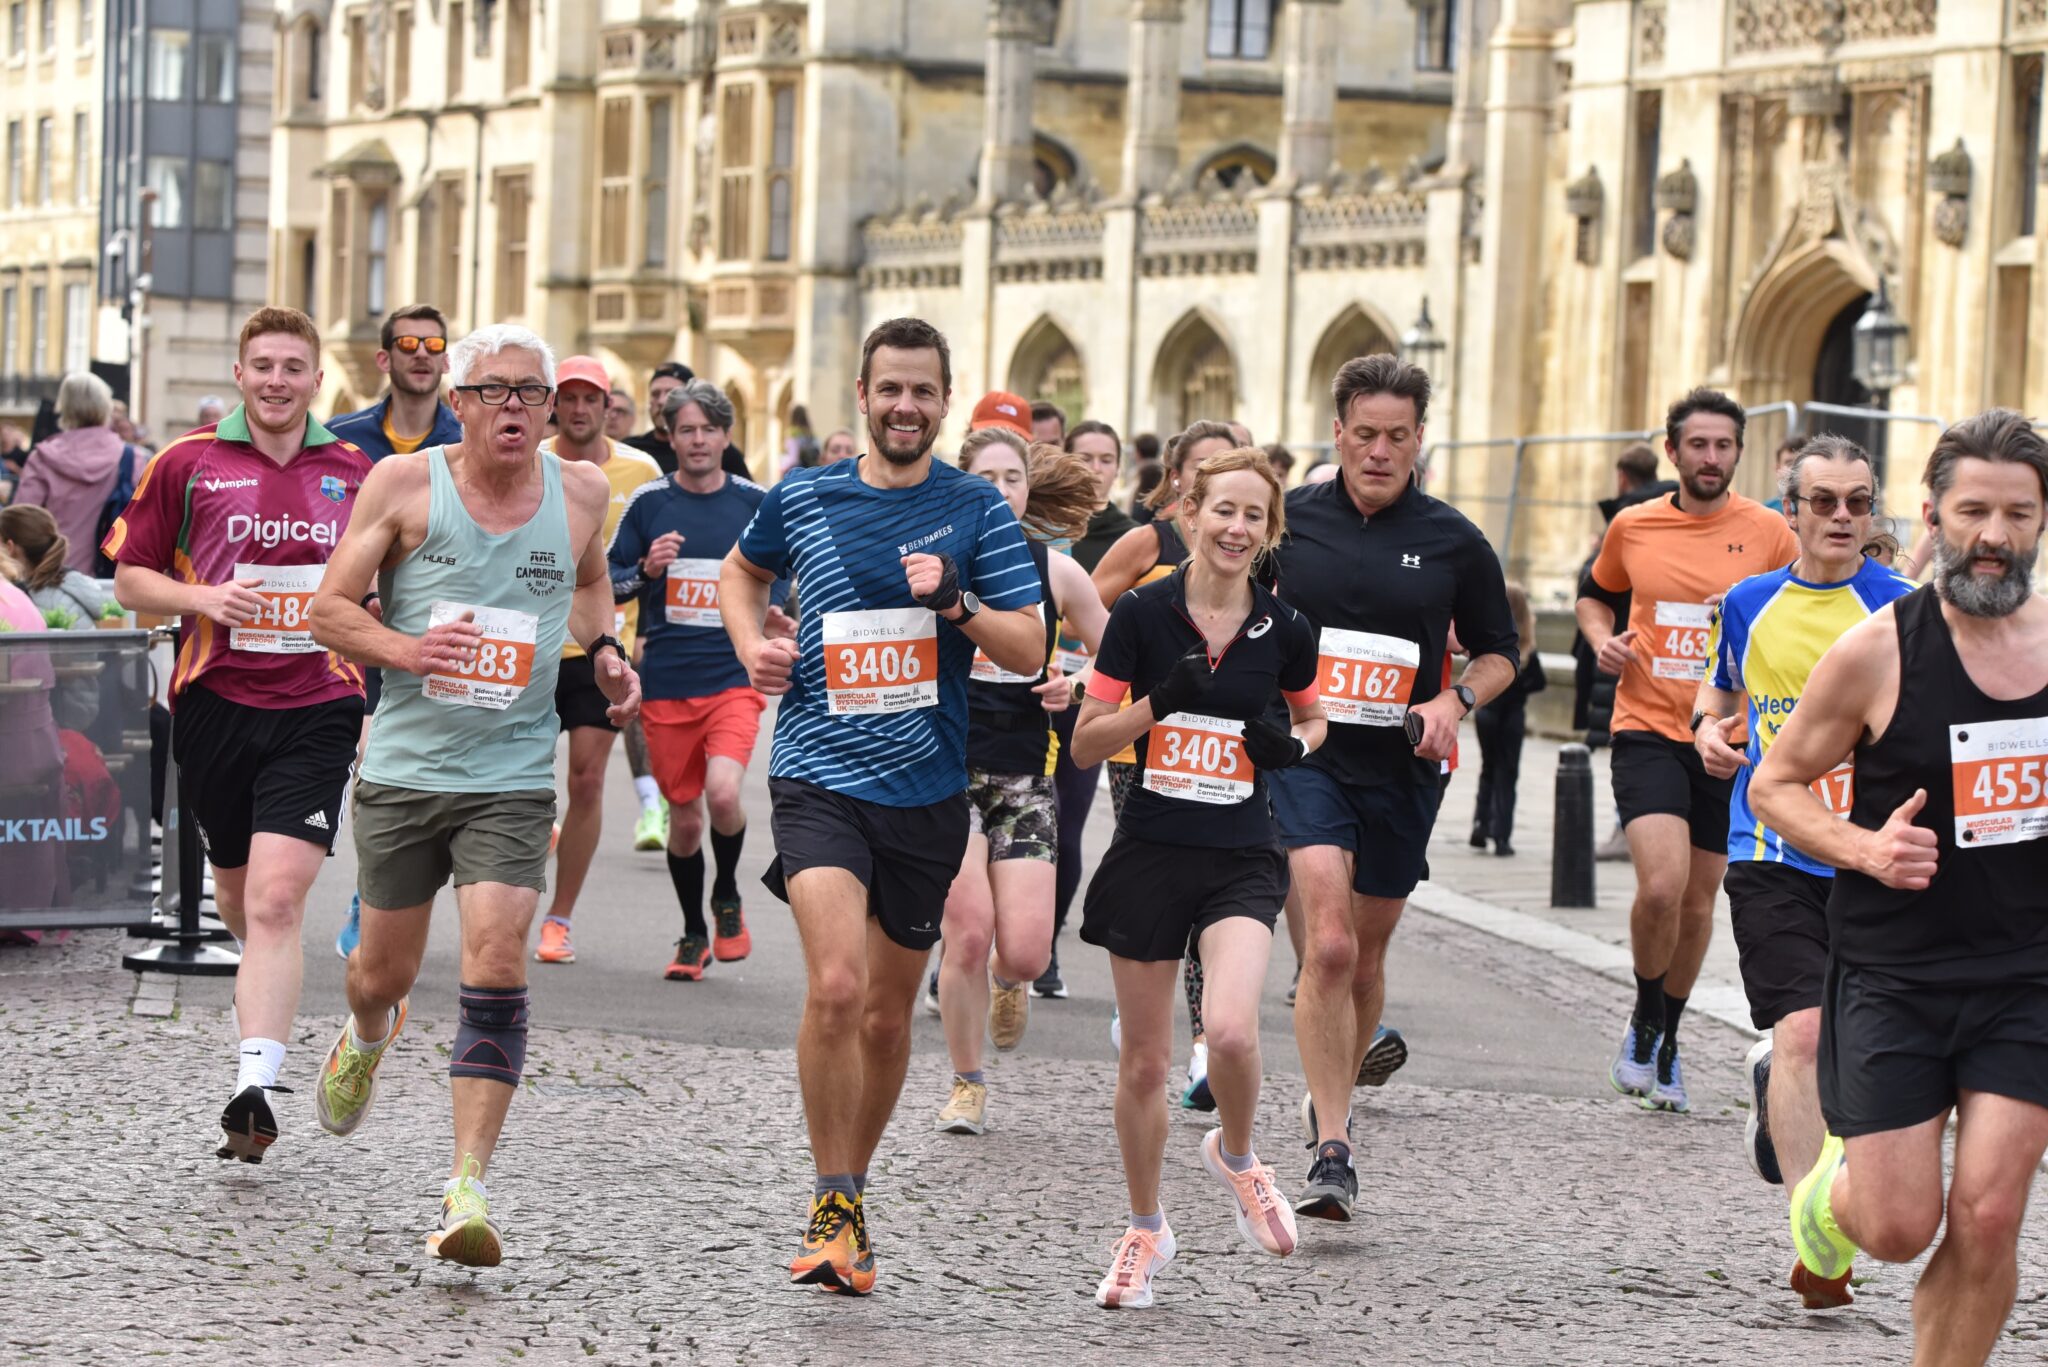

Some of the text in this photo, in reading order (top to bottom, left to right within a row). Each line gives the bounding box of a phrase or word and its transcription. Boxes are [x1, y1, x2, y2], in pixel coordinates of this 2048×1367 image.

[205, 477, 258, 492] Vampire
[227, 513, 337, 548] Digicel
[908, 524, 953, 551] BEN PARKES
[422, 554, 456, 565] HUUB
[516, 567, 565, 583] CAMBRIDGE
[526, 582, 556, 597] MARATHON
[536, 580, 548, 588] HALF
[677, 581, 720, 606] 479
[852, 627, 905, 638] BIDWELLS
[1347, 646, 1393, 659] BIDWELLS
[840, 644, 921, 684] 3406
[429, 679, 468, 689] MUSCULAR
[1328, 661, 1401, 699] 5162
[428, 684, 470, 696] DYSTROPHY
[474, 688, 502, 697] Bidwells
[835, 692, 876, 700] MUSCULAR
[883, 692, 911, 700] Bidwells
[473, 695, 511, 705] Cambridge
[835, 698, 879, 706] DYSTROPHY
[883, 693, 932, 707] Cambridge 10k
[1181, 714, 1232, 728] BIDWELLS
[1161, 731, 1239, 775] 3405
[1150, 774, 1192, 784] MUSCULAR
[1150, 780, 1194, 790] DYSTROPHY
[1198, 782, 1226, 791] Bidwells
[1196, 789, 1235, 801] Cambridge
[304, 818, 330, 830] adidas
[1966, 816, 2013, 828] MUSCULAR
[0, 816, 108, 843] KTAILS
[1971, 824, 2016, 835] YSTROPHY
